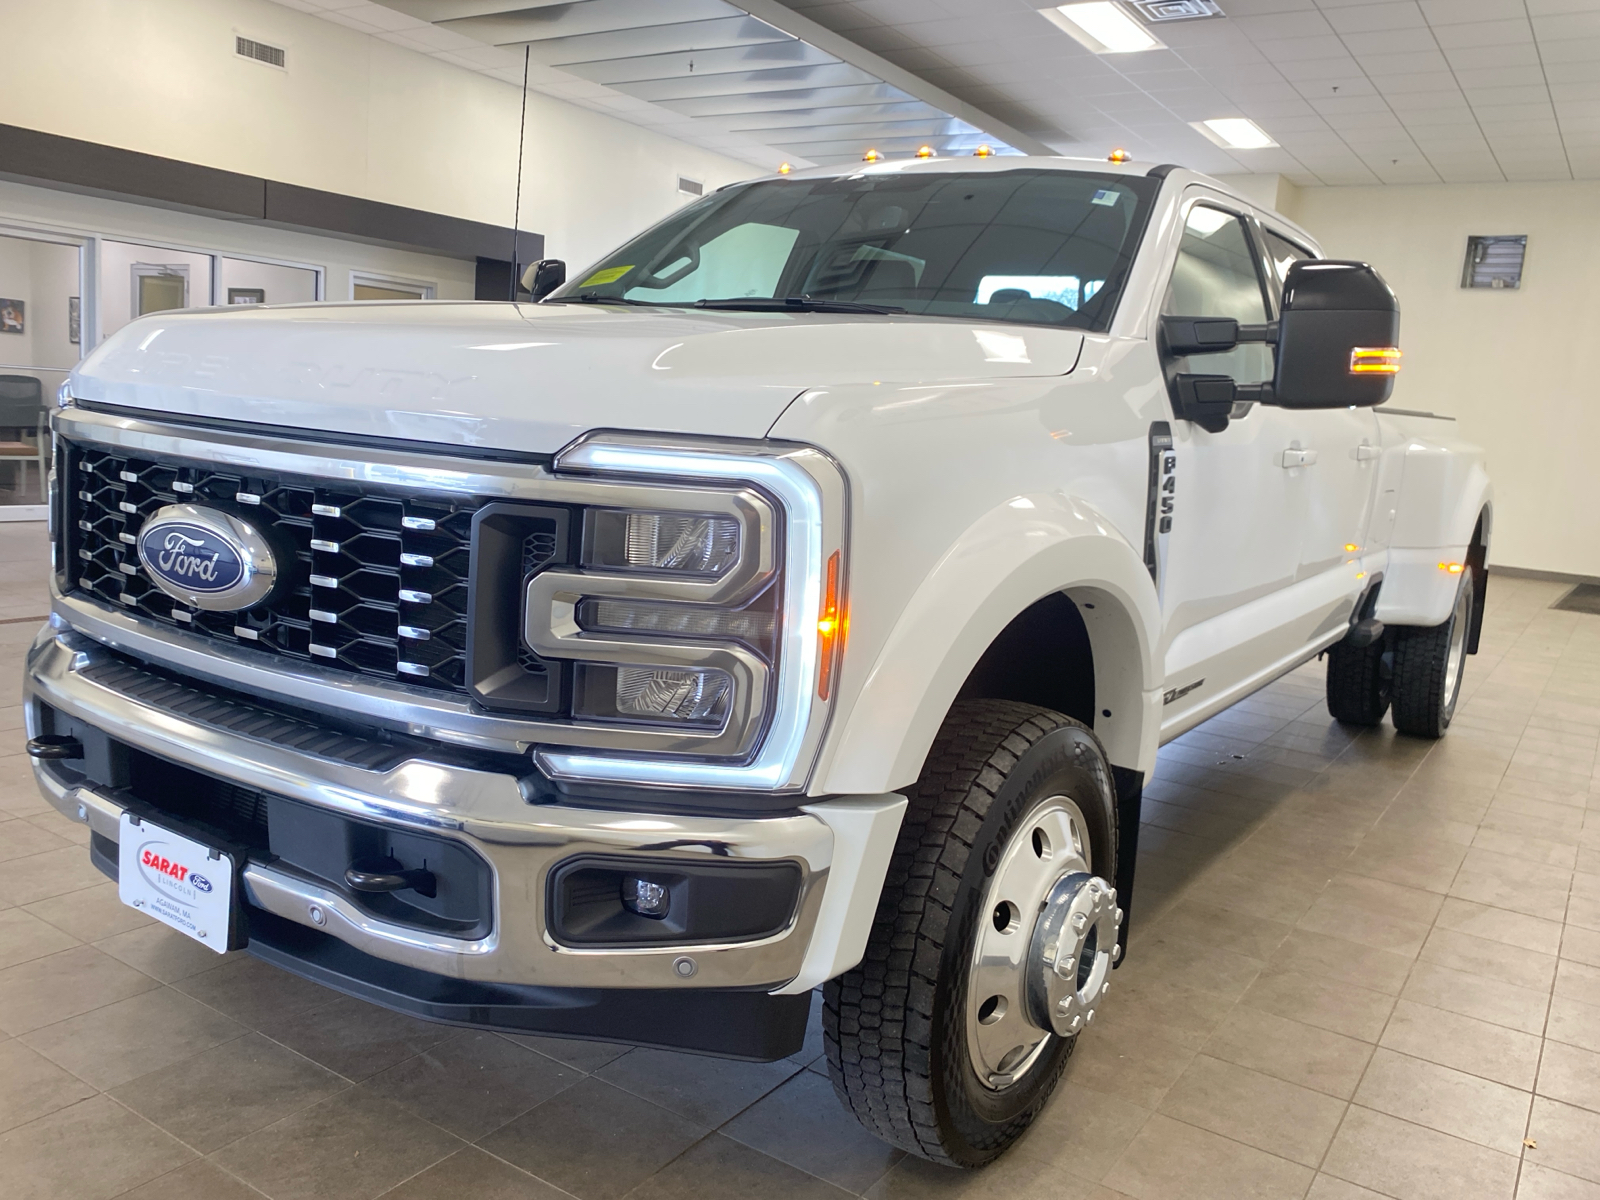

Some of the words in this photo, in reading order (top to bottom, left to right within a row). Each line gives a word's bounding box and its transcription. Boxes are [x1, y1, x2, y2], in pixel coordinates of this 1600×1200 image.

[158, 532, 220, 582] Ford
[142, 850, 188, 882] SARAT
[162, 877, 192, 896] LINCOLN
[192, 875, 210, 891] Ford
